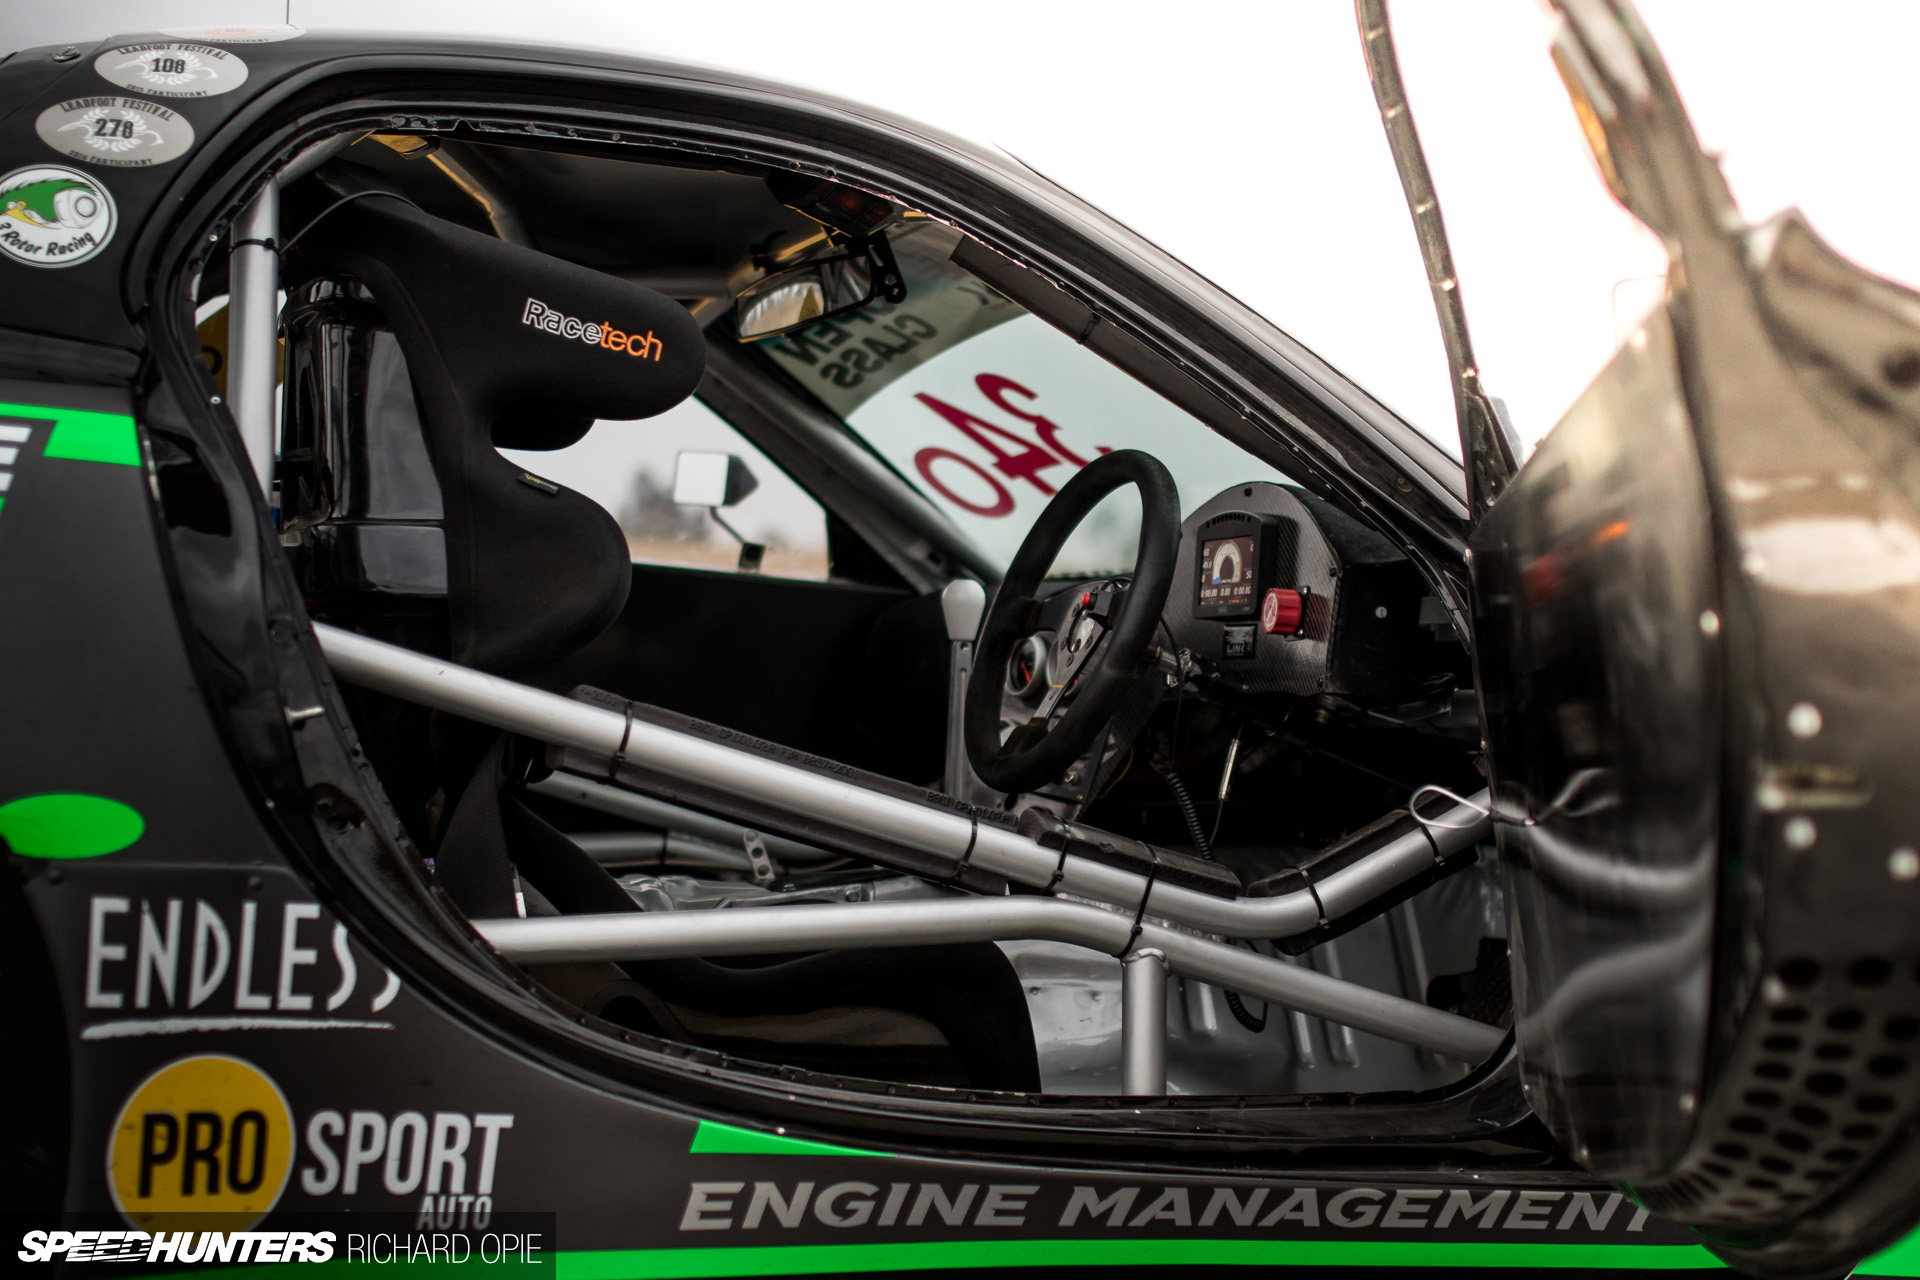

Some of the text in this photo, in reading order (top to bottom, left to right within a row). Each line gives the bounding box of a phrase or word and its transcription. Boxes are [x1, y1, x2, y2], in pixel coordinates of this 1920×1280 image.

[117, 43, 229, 60] LEADFOOT FESTIVAL
[147, 89, 208, 97] PARTICIPANT
[60, 97, 175, 121] LEADFOOT FESTIVAL
[94, 118, 134, 139] 278
[1, 231, 42, 254] Rotor
[46, 232, 98, 256] Racing
[522, 297, 662, 361] Racetech
[138, 1109, 514, 1199] PRO SPORT
[416, 1195, 493, 1231] AUTO
[679, 1181, 1041, 1231] ENGINE
